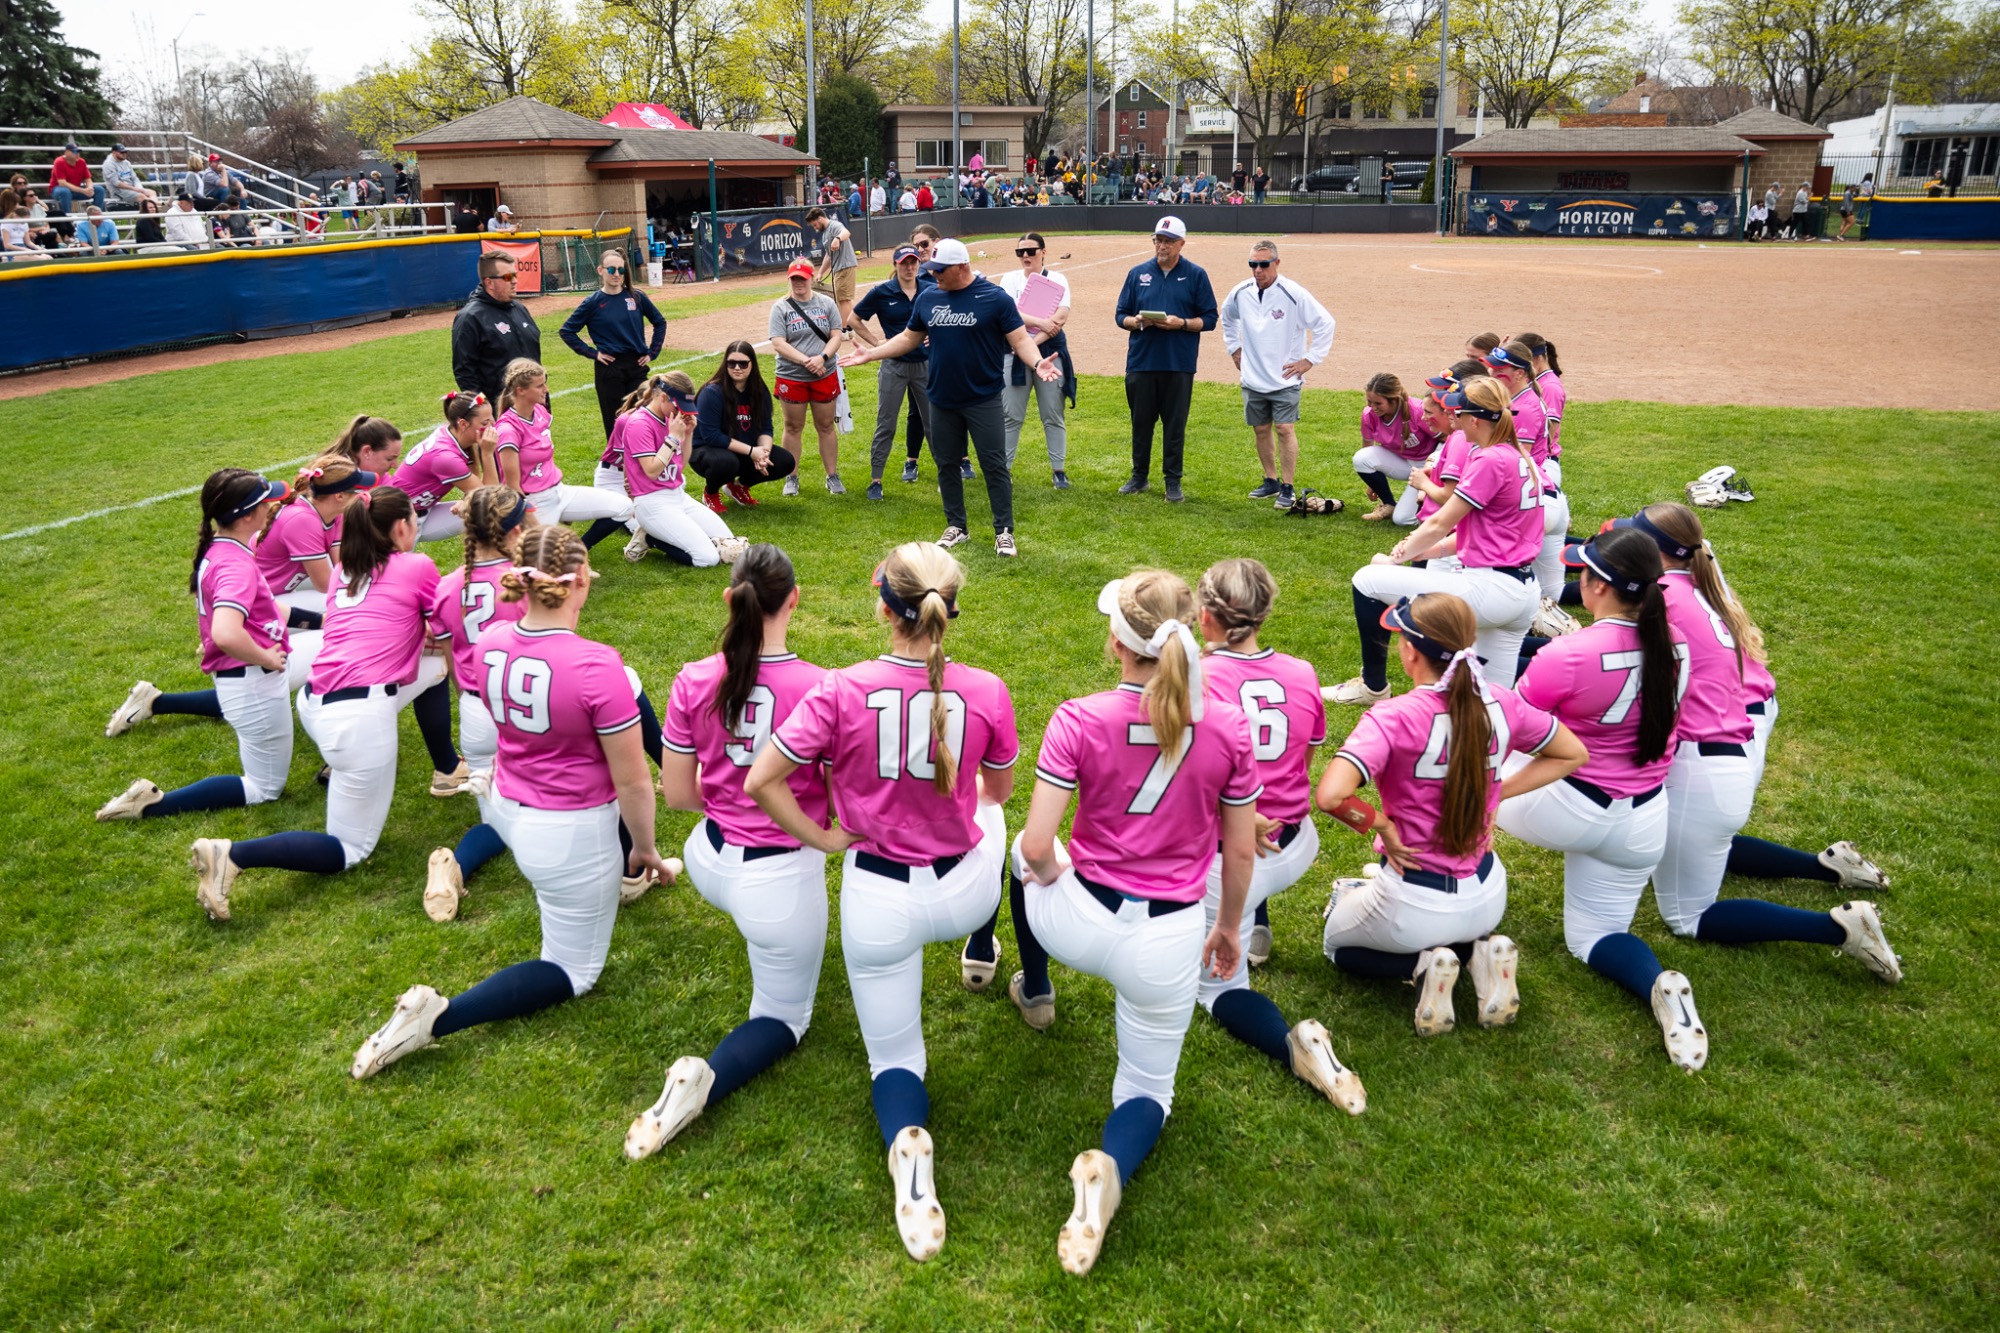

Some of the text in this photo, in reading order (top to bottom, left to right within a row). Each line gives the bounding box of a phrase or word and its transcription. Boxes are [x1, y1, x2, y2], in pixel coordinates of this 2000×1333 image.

[1199, 119, 1227, 127] SERVICE
[760, 232, 803, 252] HORIZON
[1558, 225, 1633, 235] LEAGUE
[1559, 211, 1635, 225] HORIZON
[928, 304, 978, 327] Titans
[461, 581, 496, 645] 2
[483, 649, 553, 735] 19
[1238, 678, 1290, 762] 6
[724, 684, 776, 768] 9
[866, 687, 967, 781] 10
[1125, 722, 1194, 815] 7
